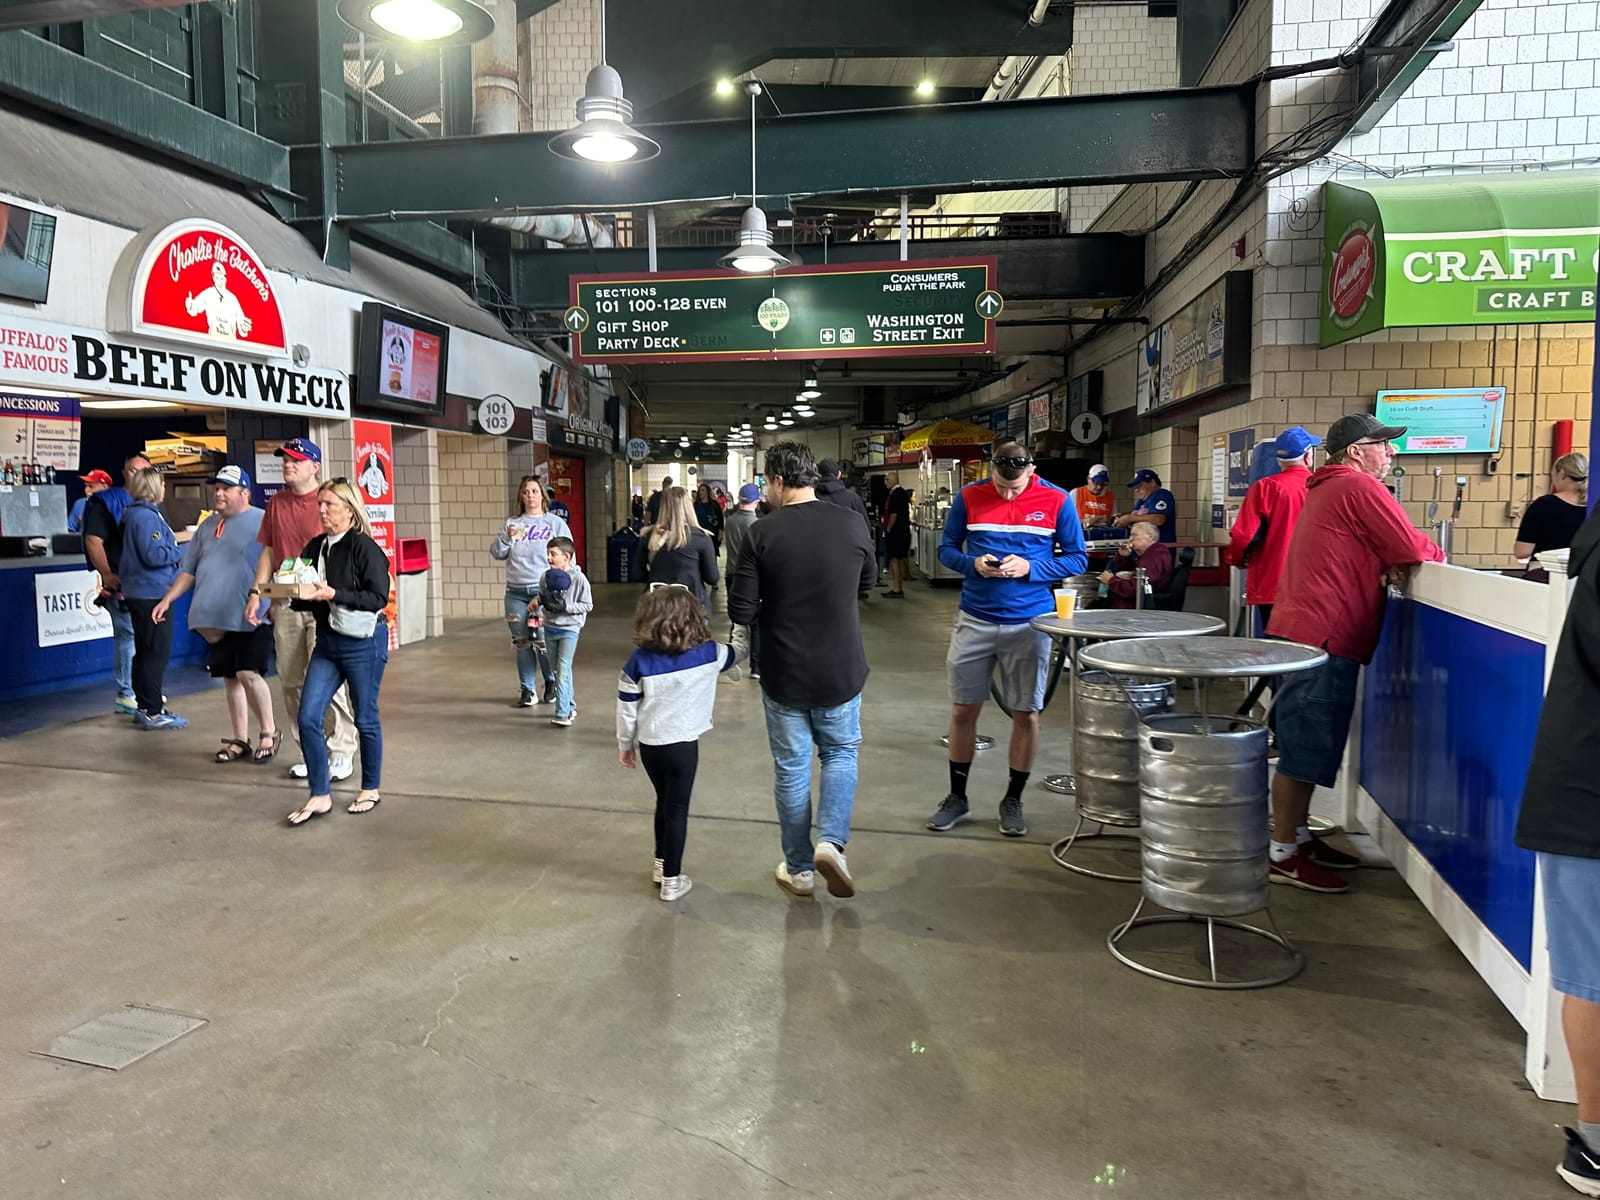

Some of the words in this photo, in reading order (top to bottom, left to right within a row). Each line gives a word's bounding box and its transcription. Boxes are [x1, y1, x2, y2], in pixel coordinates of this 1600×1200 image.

[169, 236, 212, 282] Charlie
[213, 238, 228, 263] the
[1403, 248, 1576, 283] CRAFT
[890, 273, 958, 283] CONSUMERS
[595, 287, 657, 298] SECTIONS
[883, 284, 903, 292] PUB
[904, 283, 916, 291] AT
[918, 282, 937, 290] THE
[939, 281, 966, 289] PARK
[595, 300, 619, 313] 101
[629, 297, 691, 312] 100-128
[694, 298, 727, 309] EVEN
[1489, 291, 1571, 309] CRAFT
[596, 321, 628, 333] GIFT
[632, 320, 669, 332] SHOP
[866, 313, 964, 328] WASHINGTON
[873, 328, 927, 342] STREET
[933, 327, 965, 340] EXIT
[598, 337, 639, 350] PARTY
[643, 336, 680, 348] DECK
[3, 350, 69, 374] FAMOUS
[71, 334, 195, 392] BEEF
[200, 358, 247, 399] ON
[251, 363, 345, 411] WECK
[0, 397, 61, 413] NCESSIONS
[486, 402, 507, 415] 101
[485, 416, 508, 429] 103
[631, 441, 645, 449] 100
[44, 592, 82, 613] TASTE
